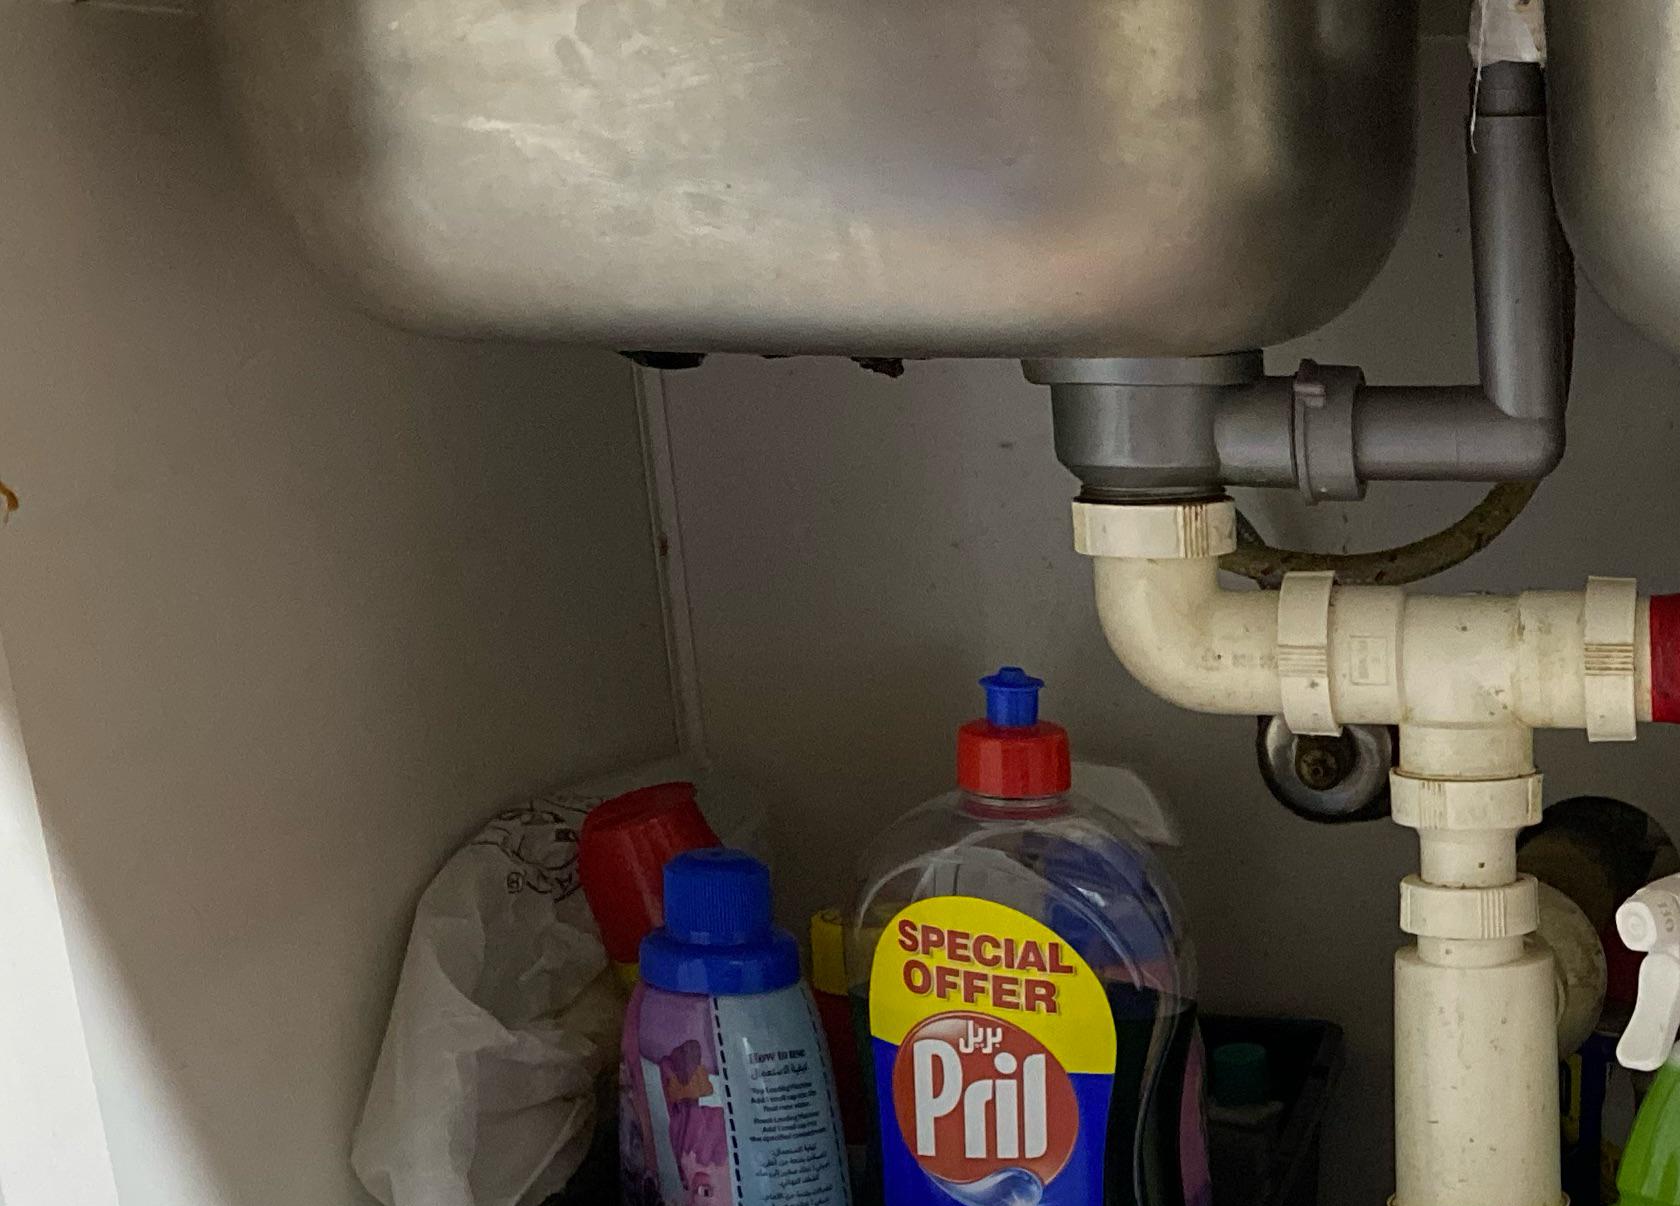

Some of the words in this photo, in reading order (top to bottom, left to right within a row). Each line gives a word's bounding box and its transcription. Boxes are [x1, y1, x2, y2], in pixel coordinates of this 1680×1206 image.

[898, 920, 1075, 975] SPECIAL
[903, 960, 1058, 1014] OFFER
[959, 1020, 1003, 1054] بريل
[913, 1038, 1047, 1159] Pril
